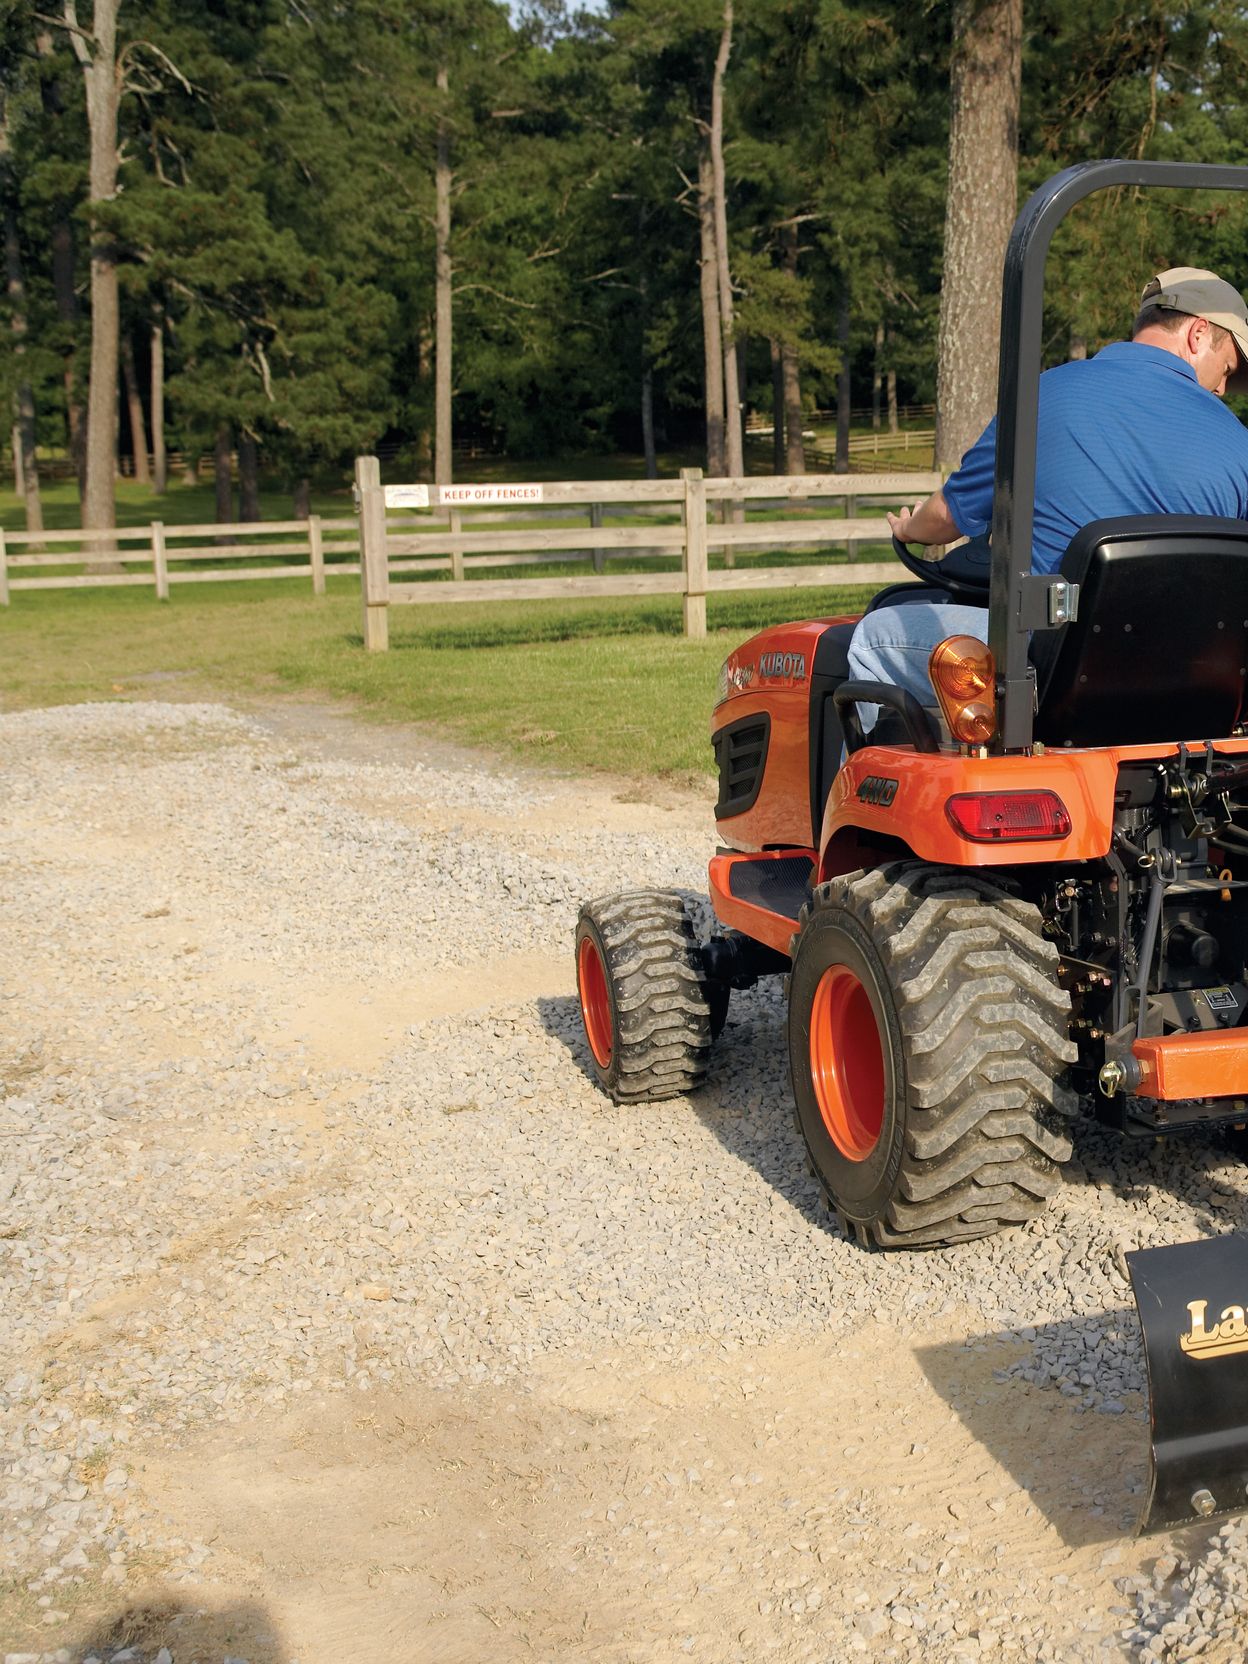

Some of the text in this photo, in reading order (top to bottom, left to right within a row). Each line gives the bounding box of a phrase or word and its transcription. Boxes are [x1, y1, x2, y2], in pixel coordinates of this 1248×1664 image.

[444, 488, 540, 500] KEEP OFF FENCES!
[759, 652, 806, 680] KUBOTA
[856, 775, 899, 807] 4WD
